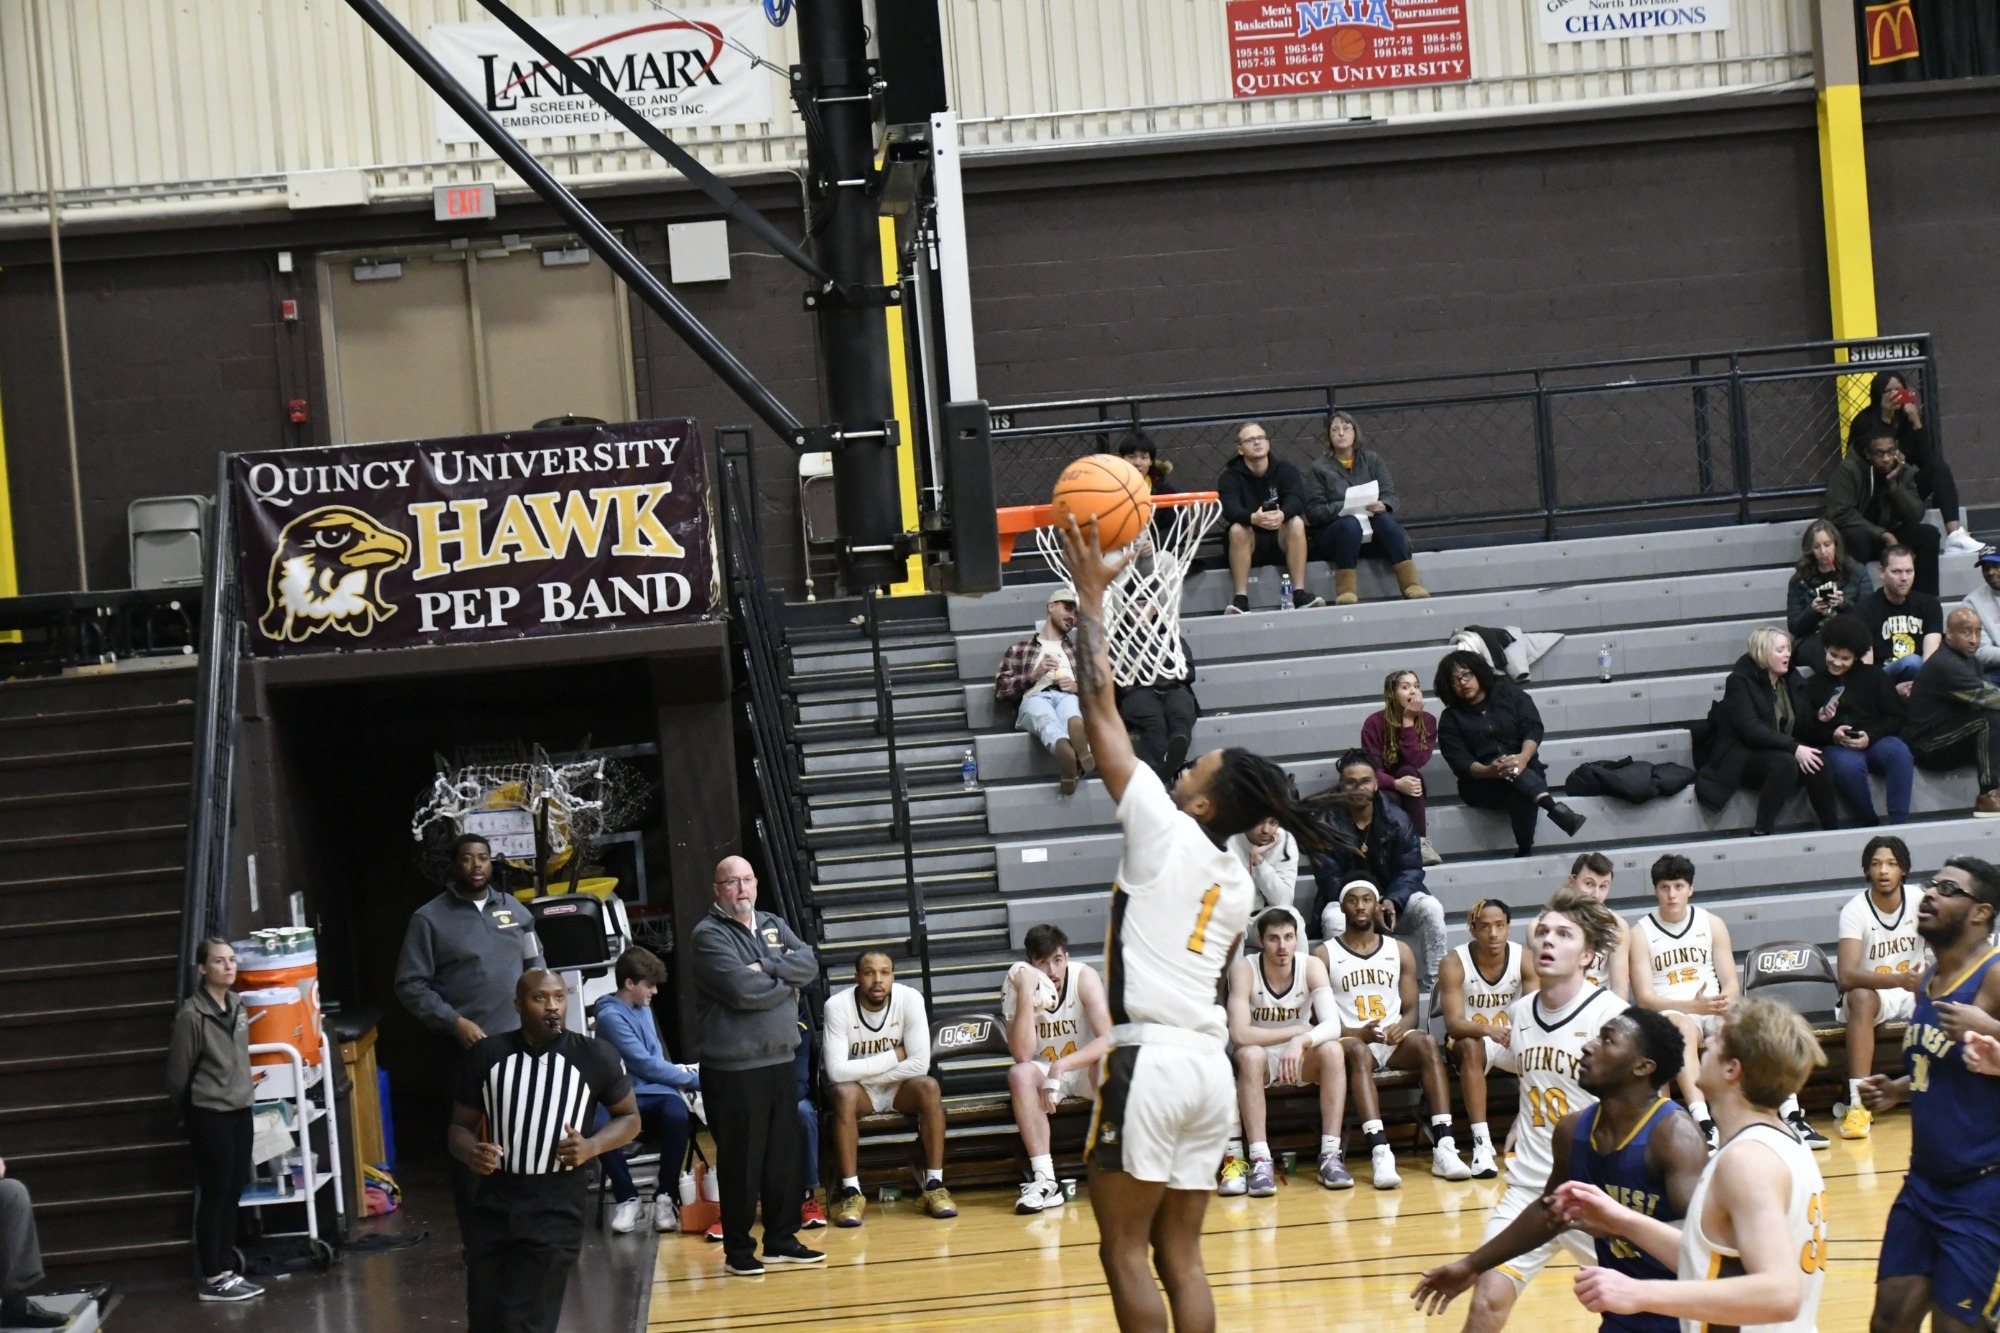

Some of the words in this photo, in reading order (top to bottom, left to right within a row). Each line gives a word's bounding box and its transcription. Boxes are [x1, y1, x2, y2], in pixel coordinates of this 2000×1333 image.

[1261, 4, 1292, 17] Men's
[1391, 6, 1459, 19] Tournament
[1589, 0, 1624, 10] North
[1234, 17, 1293, 31] Basketball
[1296, 0, 1394, 38] NAIA
[1565, 6, 1706, 34] CHAMPIONS
[1236, 46, 1275, 58] 1954-55
[1284, 42, 1324, 54] 1963-64
[1373, 36, 1413, 47] 1977-78
[1422, 32, 1462, 44] 1984-85
[1237, 57, 1276, 69] 1957-58
[1285, 53, 1324, 65] 1966-67
[477, 48, 722, 112] LANDMARX
[1236, 70, 1323, 94] QUINCY
[1331, 59, 1465, 83] UNIVERSITY
[530, 100, 584, 113] SCREEN
[589, 96, 646, 109] PTED
[650, 93, 678, 105] AND
[502, 112, 600, 128] EMBROIDERED
[604, 106, 677, 121] PUCTS
[681, 104, 708, 115] INC.
[447, 188, 482, 216] EXIT
[1850, 342, 1920, 362] STUDENTS
[248, 458, 415, 507] QUINCY
[430, 437, 681, 486] UNIVERSITY
[408, 482, 686, 581] HAWK
[415, 585, 522, 633] PEP
[538, 571, 692, 623] BAND
[1187, 883, 1222, 955] 1
[1654, 947, 1708, 971] QUINCY
[1870, 937, 1916, 960] QUINCY
[1342, 969, 1394, 992] QUINCY
[1354, 994, 1387, 1021] 15
[1468, 992, 1516, 1009] QUINCY
[1253, 1006, 1302, 1022] QUINCY
[851, 1037, 899, 1057] QUINCY
[1517, 1046, 1581, 1080] QUINCY
[1528, 1085, 1569, 1128] 10
